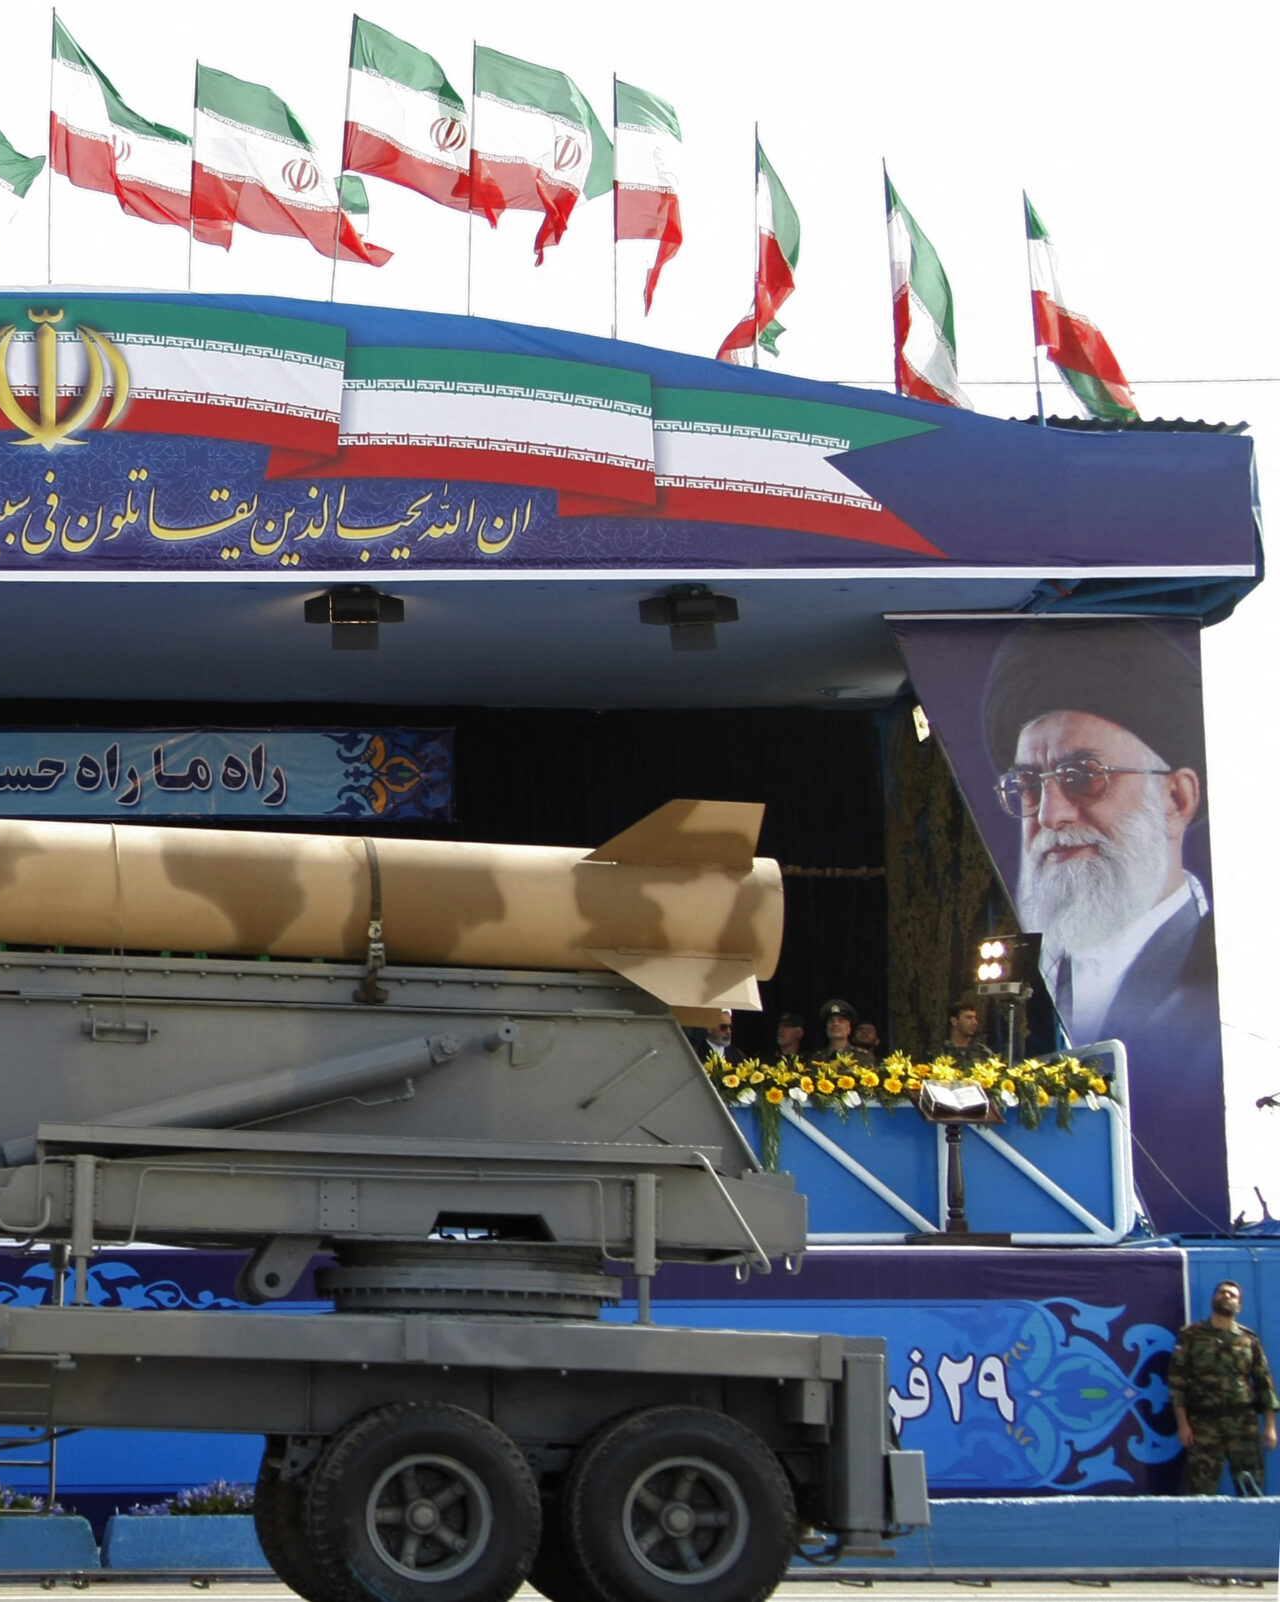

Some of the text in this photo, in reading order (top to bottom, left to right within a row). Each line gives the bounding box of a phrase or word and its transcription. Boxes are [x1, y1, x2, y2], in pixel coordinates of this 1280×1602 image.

[75, 742, 141, 806] راه
[152, 745, 213, 791] ما
[221, 742, 287, 806] راه
[935, 1352, 1017, 1425] ۲۹
